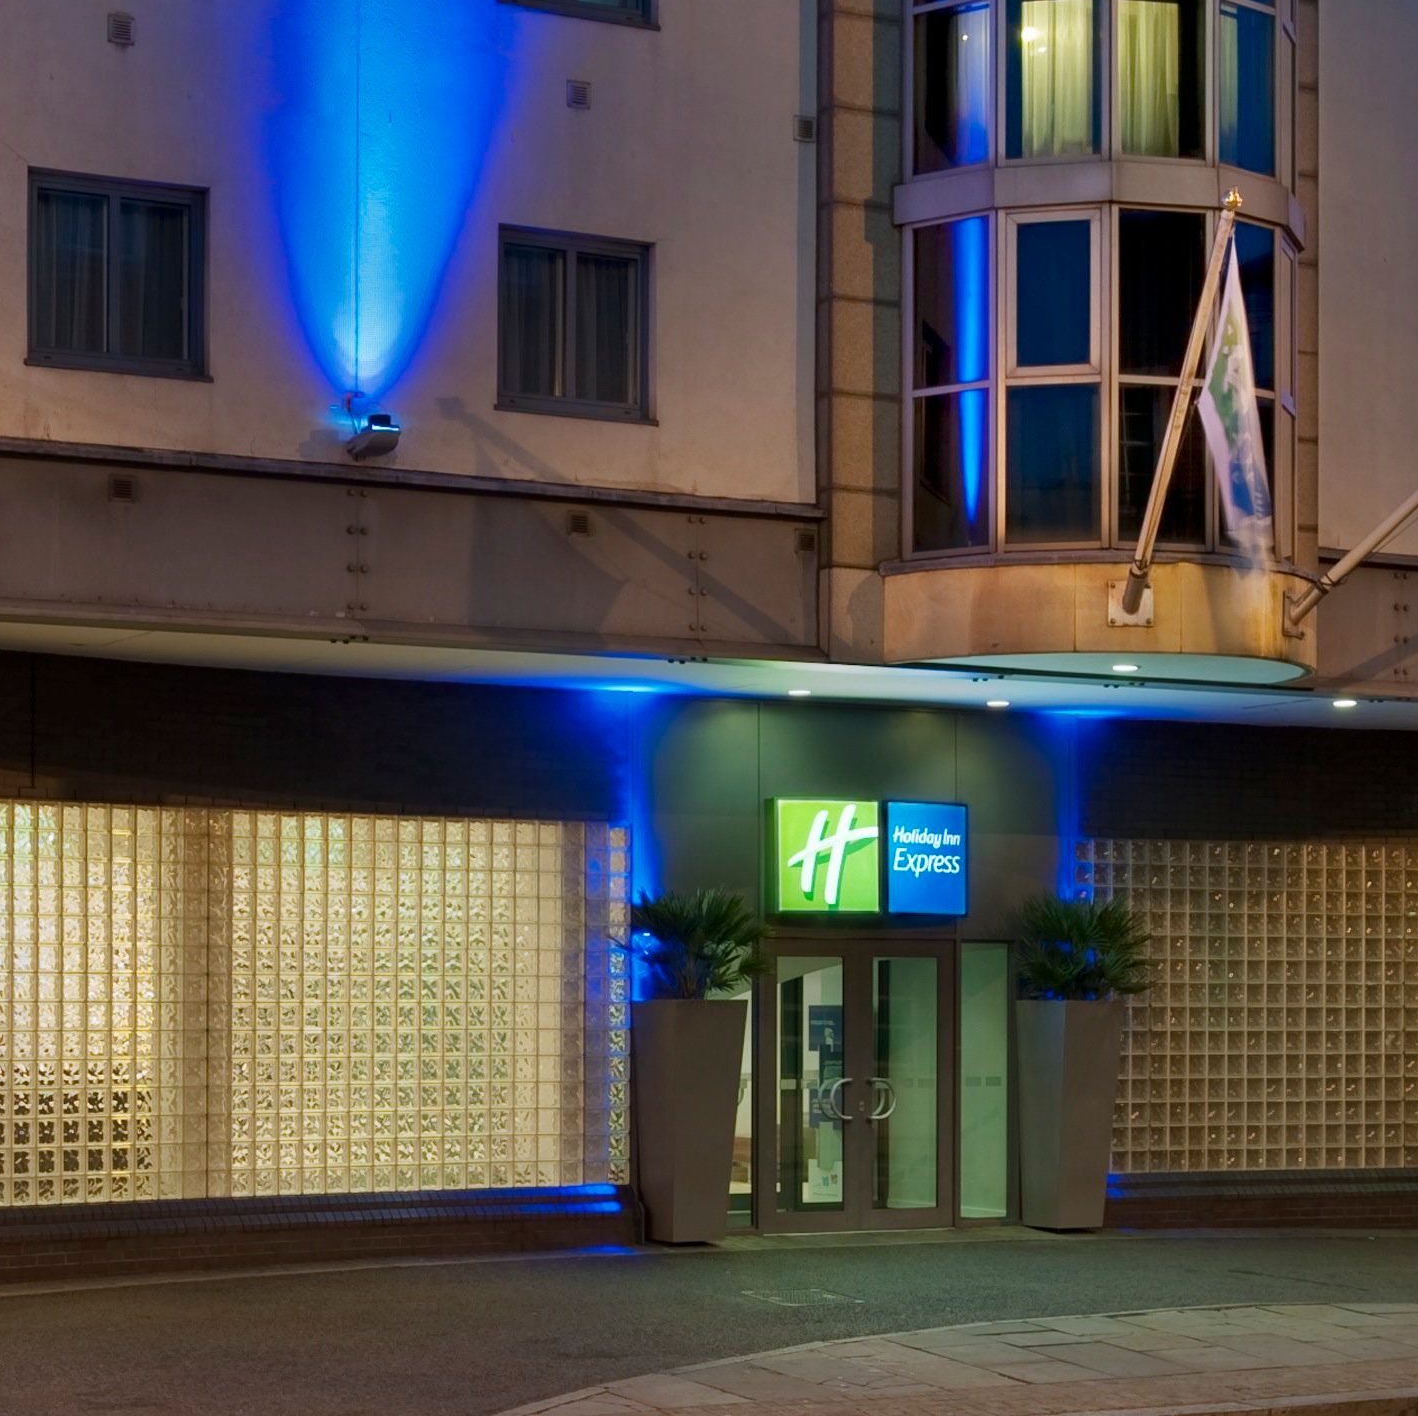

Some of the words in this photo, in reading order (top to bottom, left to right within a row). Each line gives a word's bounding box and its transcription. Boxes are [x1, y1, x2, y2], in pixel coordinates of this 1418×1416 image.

[892, 824, 941, 849] Holiday
[942, 827, 961, 847] Inn
[892, 847, 961, 878] Express
